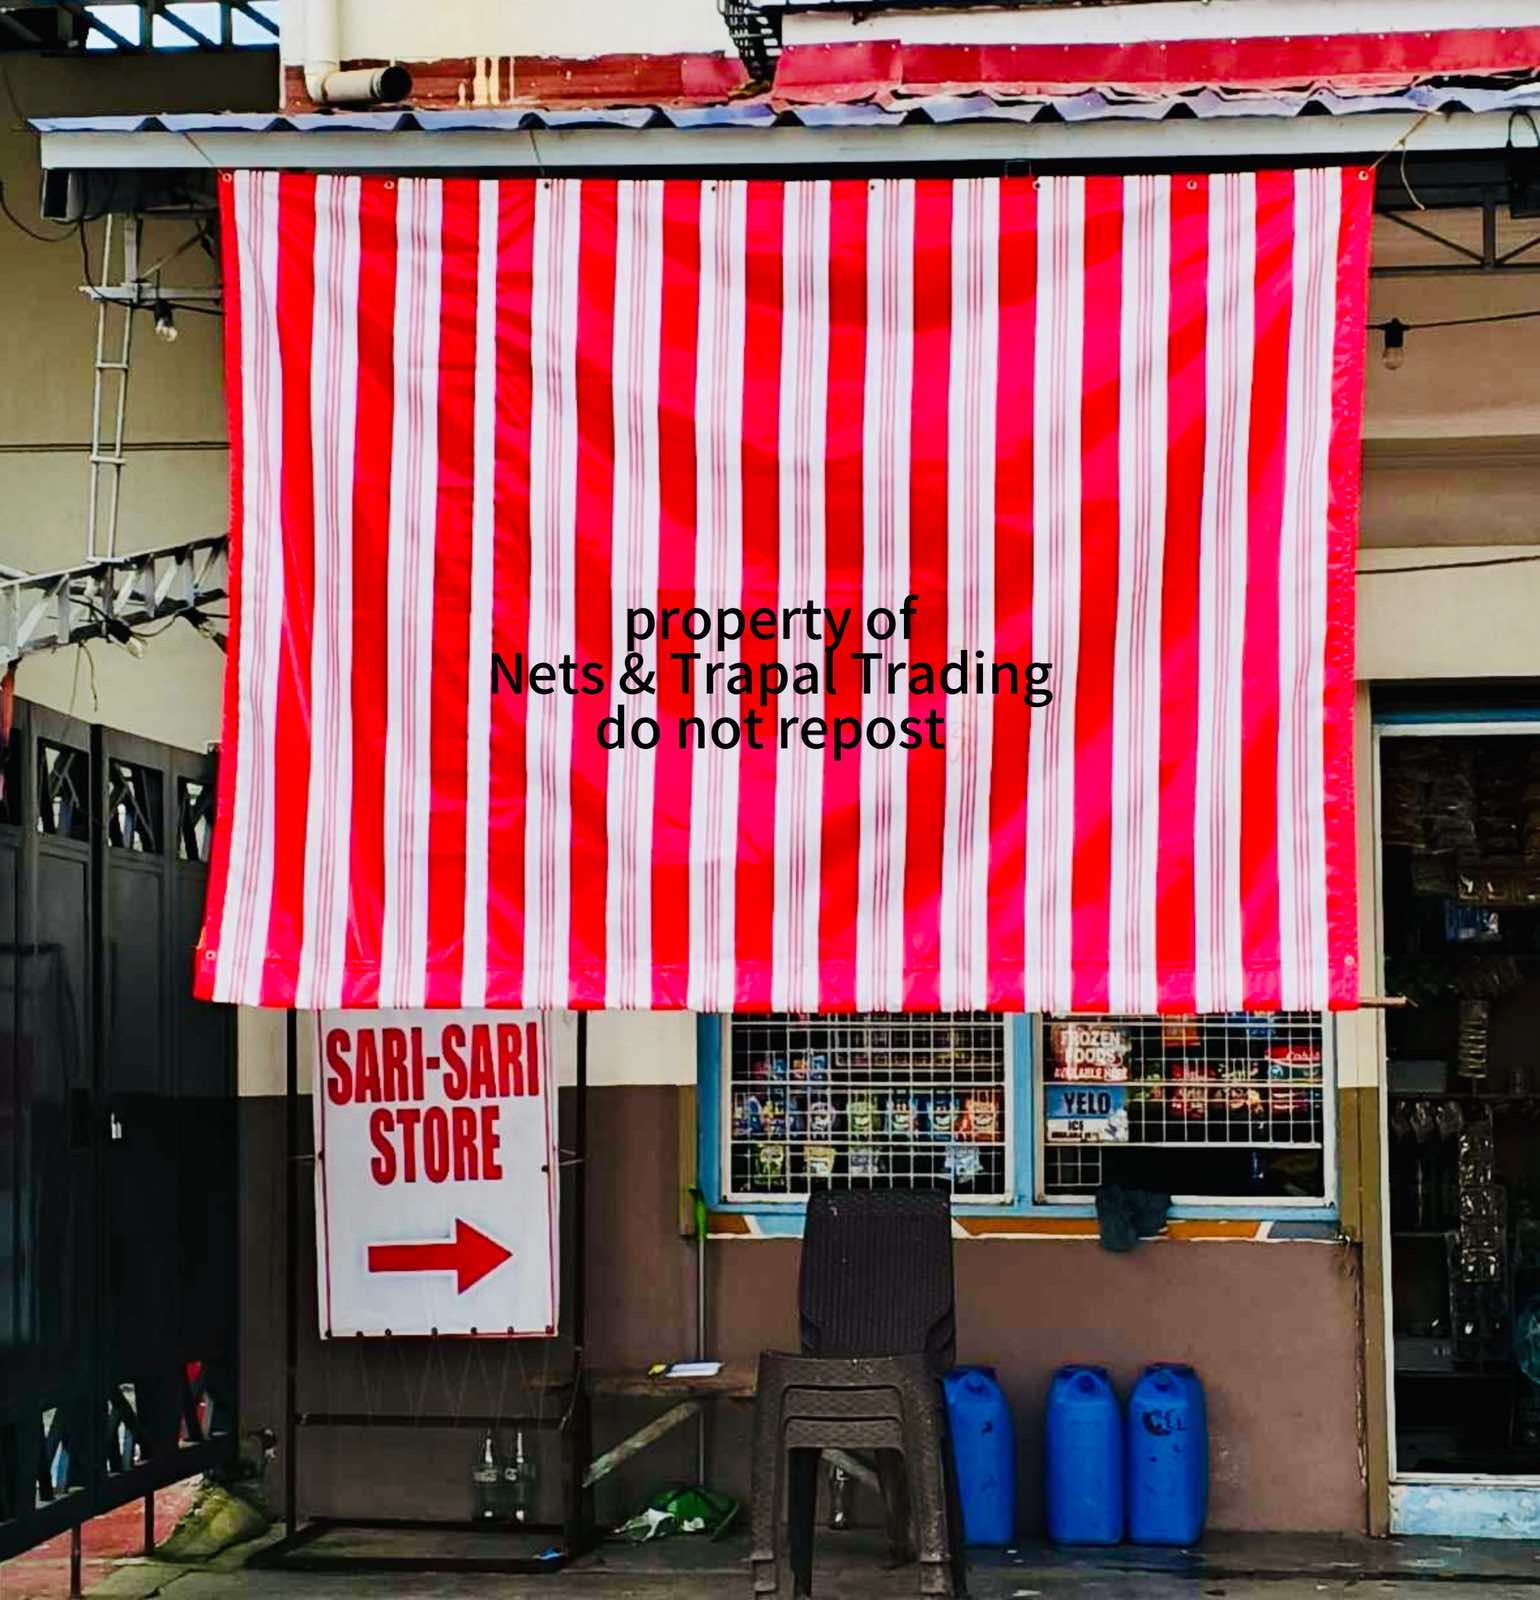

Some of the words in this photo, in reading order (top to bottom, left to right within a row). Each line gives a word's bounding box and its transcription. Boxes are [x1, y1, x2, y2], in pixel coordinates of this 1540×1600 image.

[327, 1022, 540, 1105] SARI-SARI
[1055, 1067, 1104, 1079] AVILABLE
[1064, 1091, 1111, 1114] YELO
[370, 1105, 503, 1185] STORE
